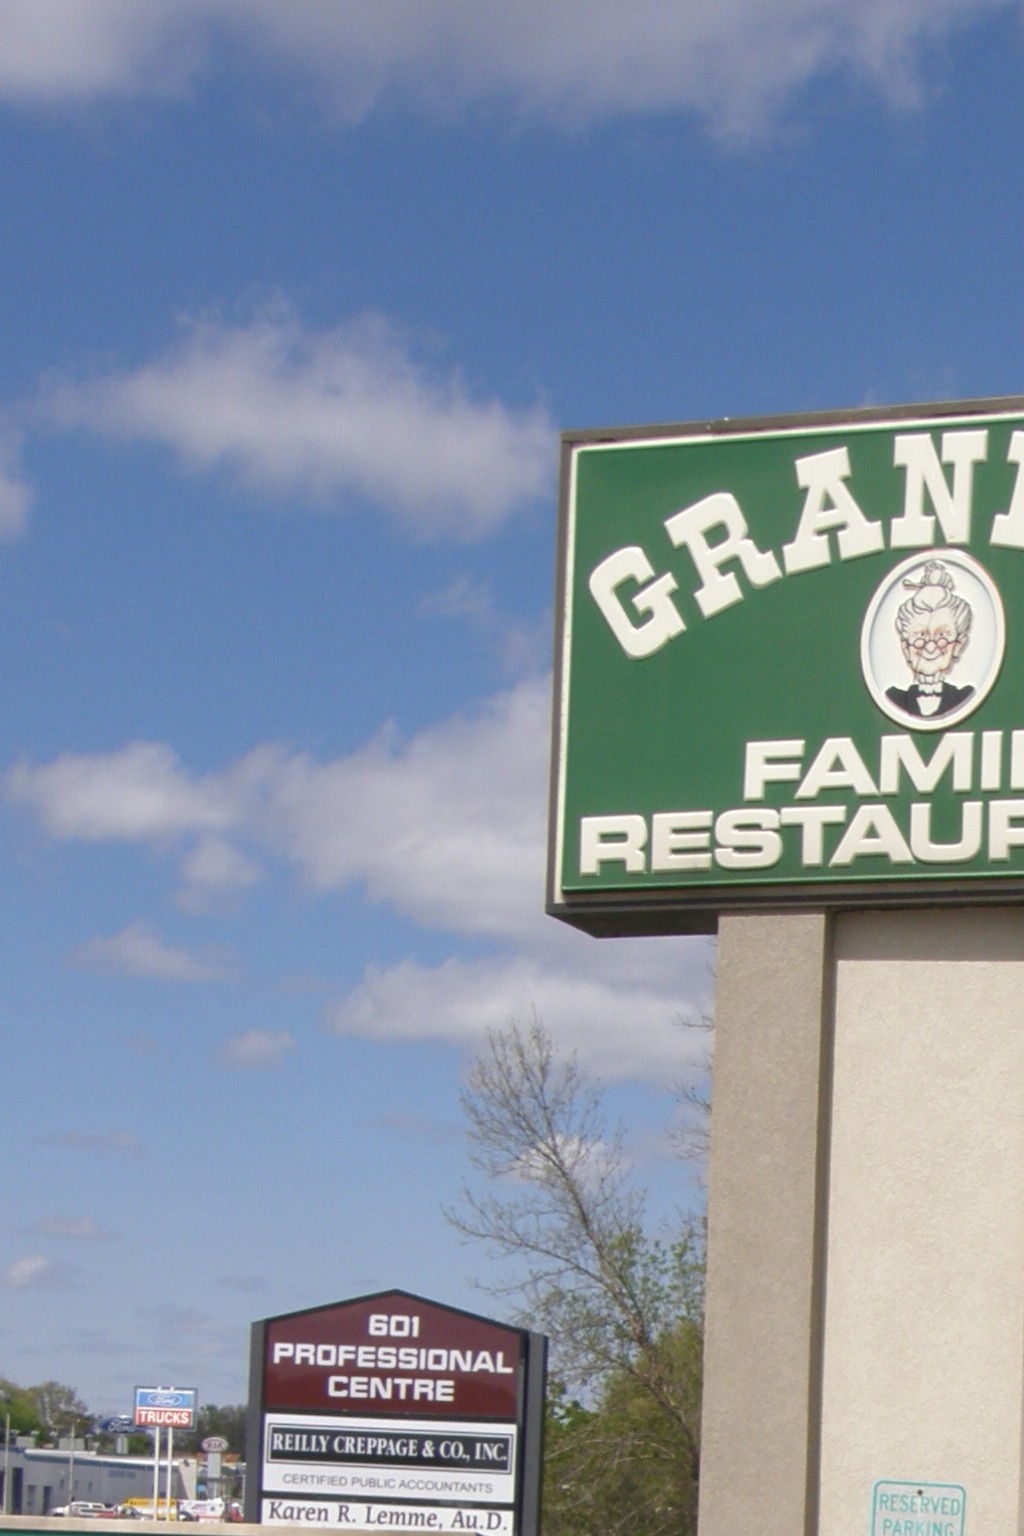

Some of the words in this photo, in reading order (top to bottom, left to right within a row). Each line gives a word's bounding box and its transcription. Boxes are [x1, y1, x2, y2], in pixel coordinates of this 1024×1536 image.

[368, 1314, 420, 1338] 601
[273, 1343, 513, 1374] PROFESSIONAL
[328, 1375, 455, 1402] CENTRE
[140, 1410, 190, 1424] TRUCKS
[272, 1433, 330, 1453] REILLY
[333, 1436, 418, 1457] CREPPAGE
[421, 1440, 435, 1458] &
[474, 1443, 507, 1461] INC.
[282, 1473, 348, 1487] CERTIFIED
[351, 1476, 396, 1489] PUBLIC
[399, 1479, 493, 1494] ACCOUNTANTS
[268, 1501, 329, 1522] Karen
[337, 1504, 356, 1523] R.
[365, 1506, 443, 1530] Lemme,
[451, 1511, 507, 1531] Au.D.
[879, 1493, 961, 1516] RESERVED
